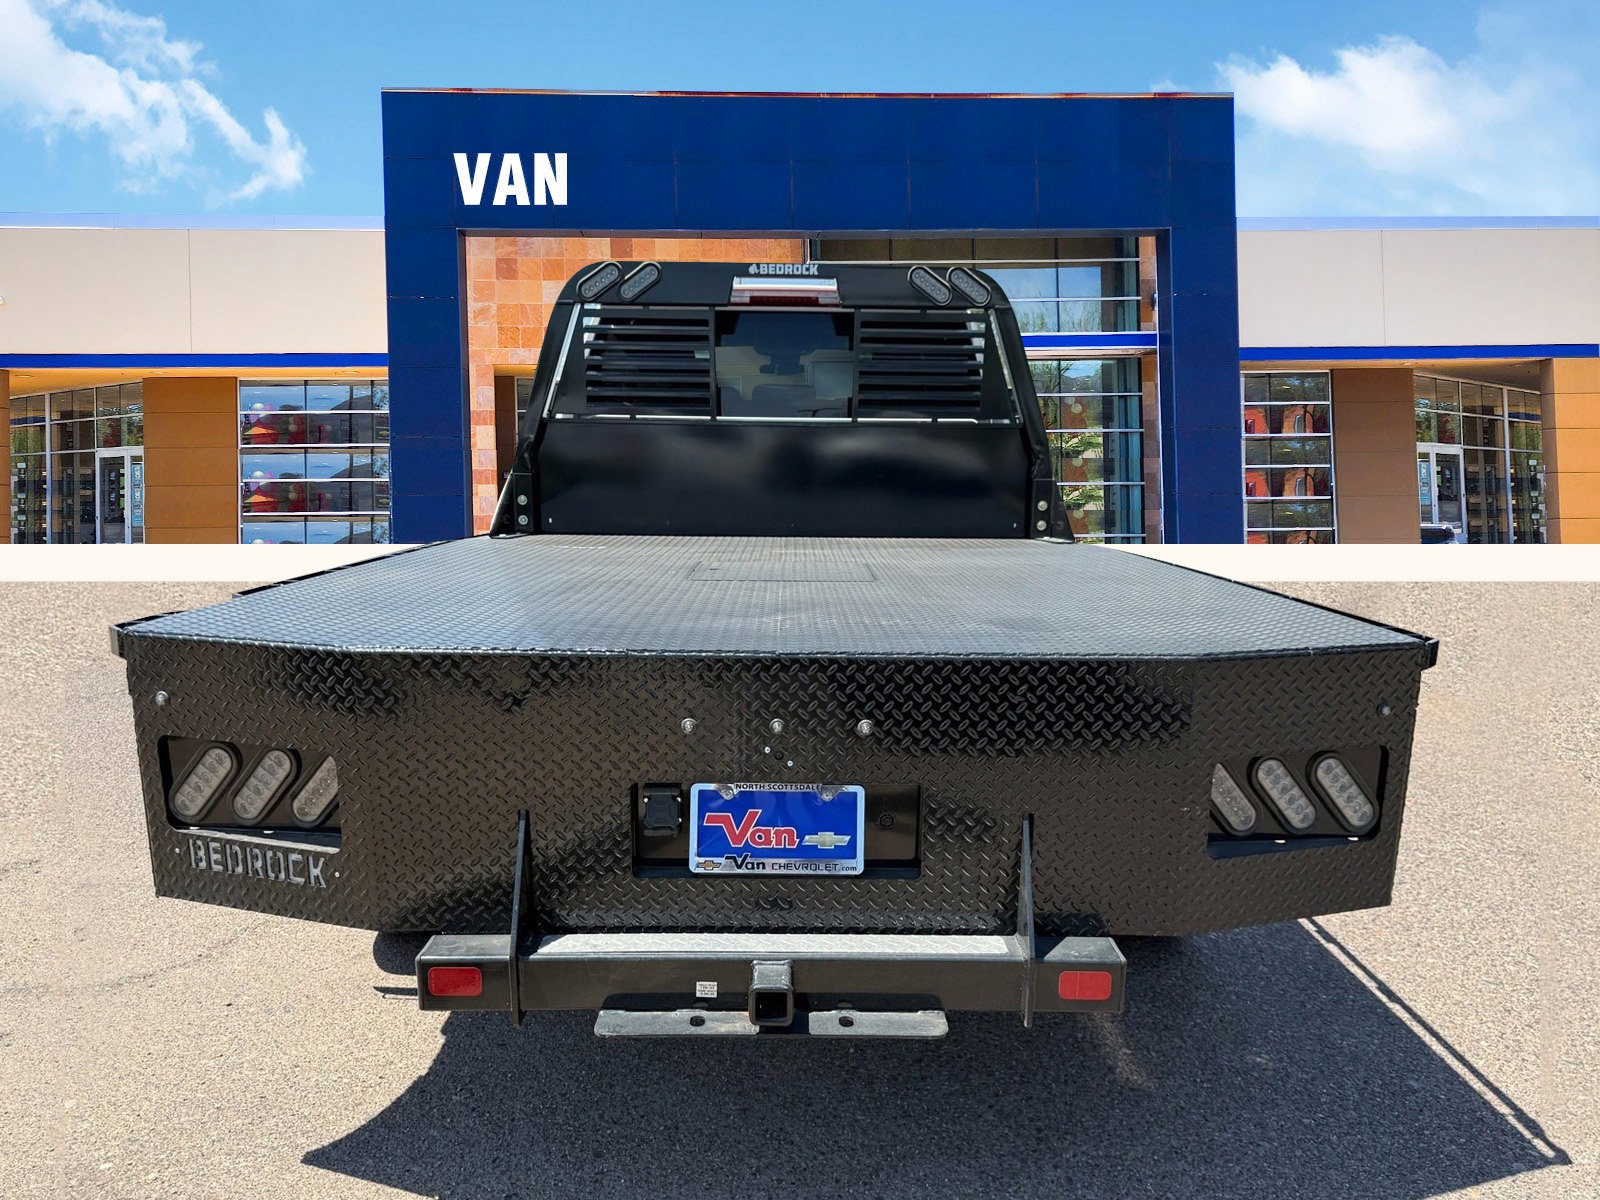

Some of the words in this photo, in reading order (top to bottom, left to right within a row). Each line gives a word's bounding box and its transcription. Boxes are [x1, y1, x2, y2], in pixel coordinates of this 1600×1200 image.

[453, 152, 568, 206] VAN
[759, 263, 819, 275] BEDROCK
[767, 783, 822, 791] SCOTTSDALE
[703, 809, 799, 848] Van
[188, 838, 326, 888] BEDROCK
[724, 853, 766, 871] Van
[771, 862, 857, 872] CHEVROLET.com
